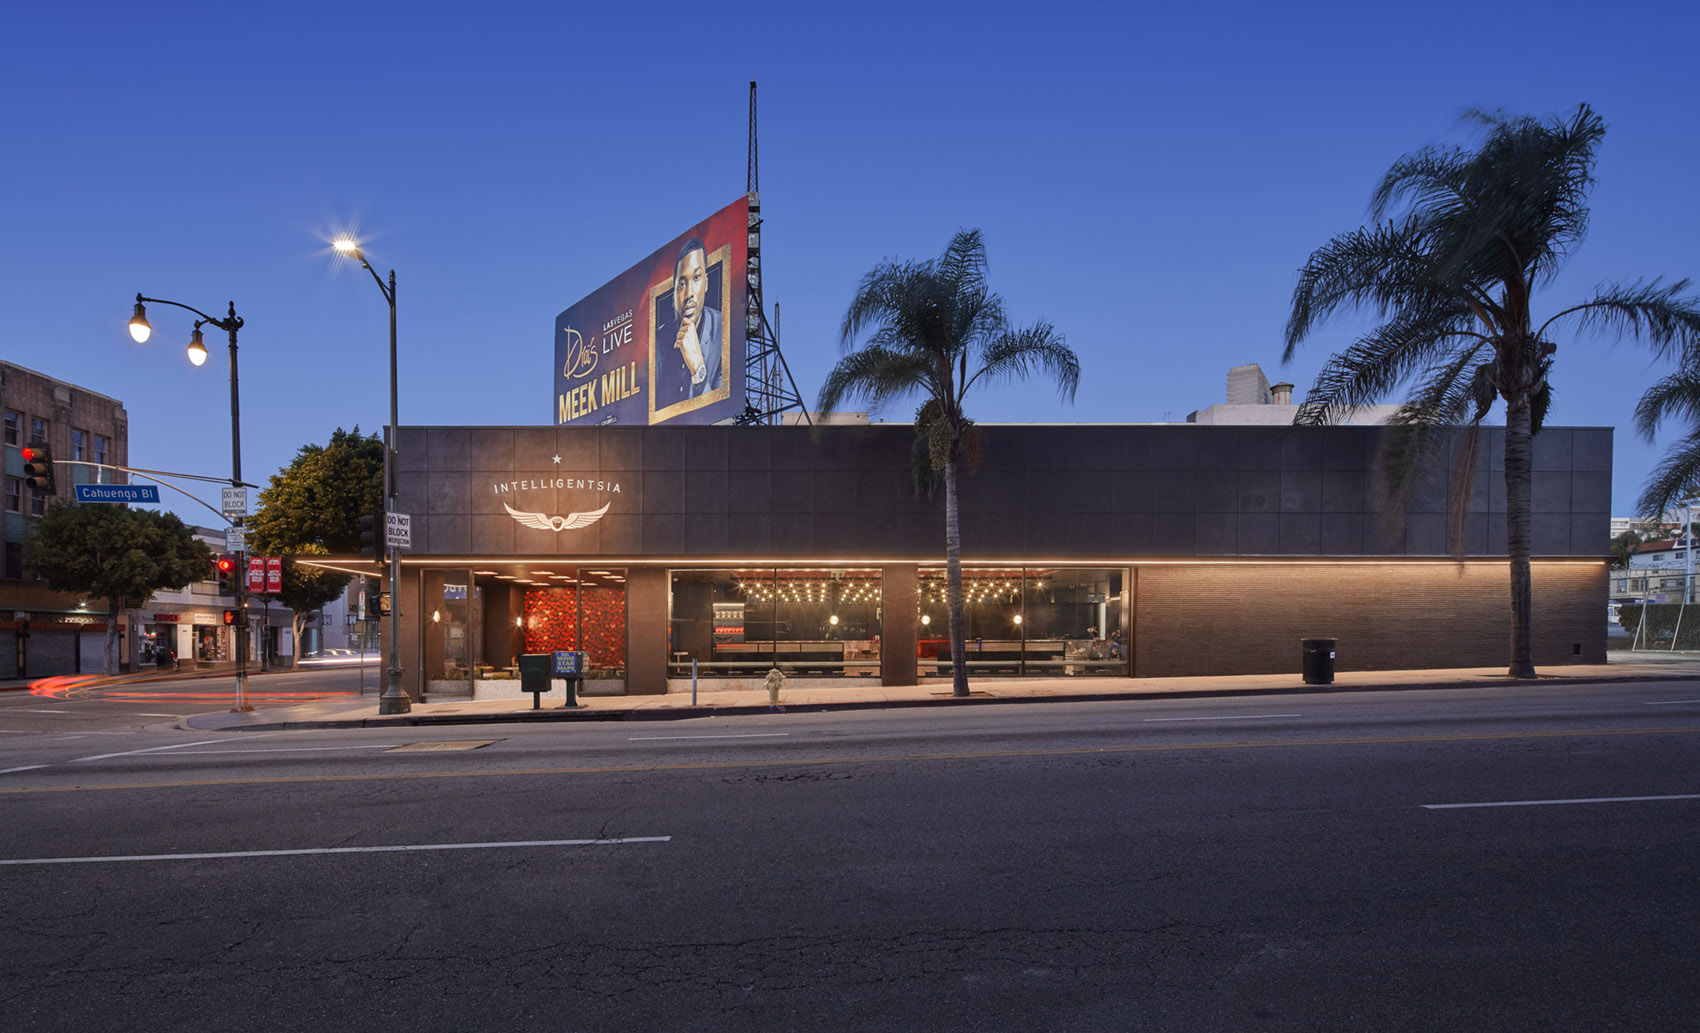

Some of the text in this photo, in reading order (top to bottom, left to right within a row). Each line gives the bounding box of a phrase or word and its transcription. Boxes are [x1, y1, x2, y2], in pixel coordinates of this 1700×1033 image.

[602, 324, 632, 354] LIVE
[559, 361, 640, 424] MEEK MILL
[494, 478, 621, 494] INTELLIGENTSIA
[82, 488, 138, 501] Cahuenga
[224, 491, 245, 499] DO NOT
[224, 500, 245, 508] BLOCK
[387, 515, 409, 526] DO NOT
[388, 527, 409, 537] BLOCK
